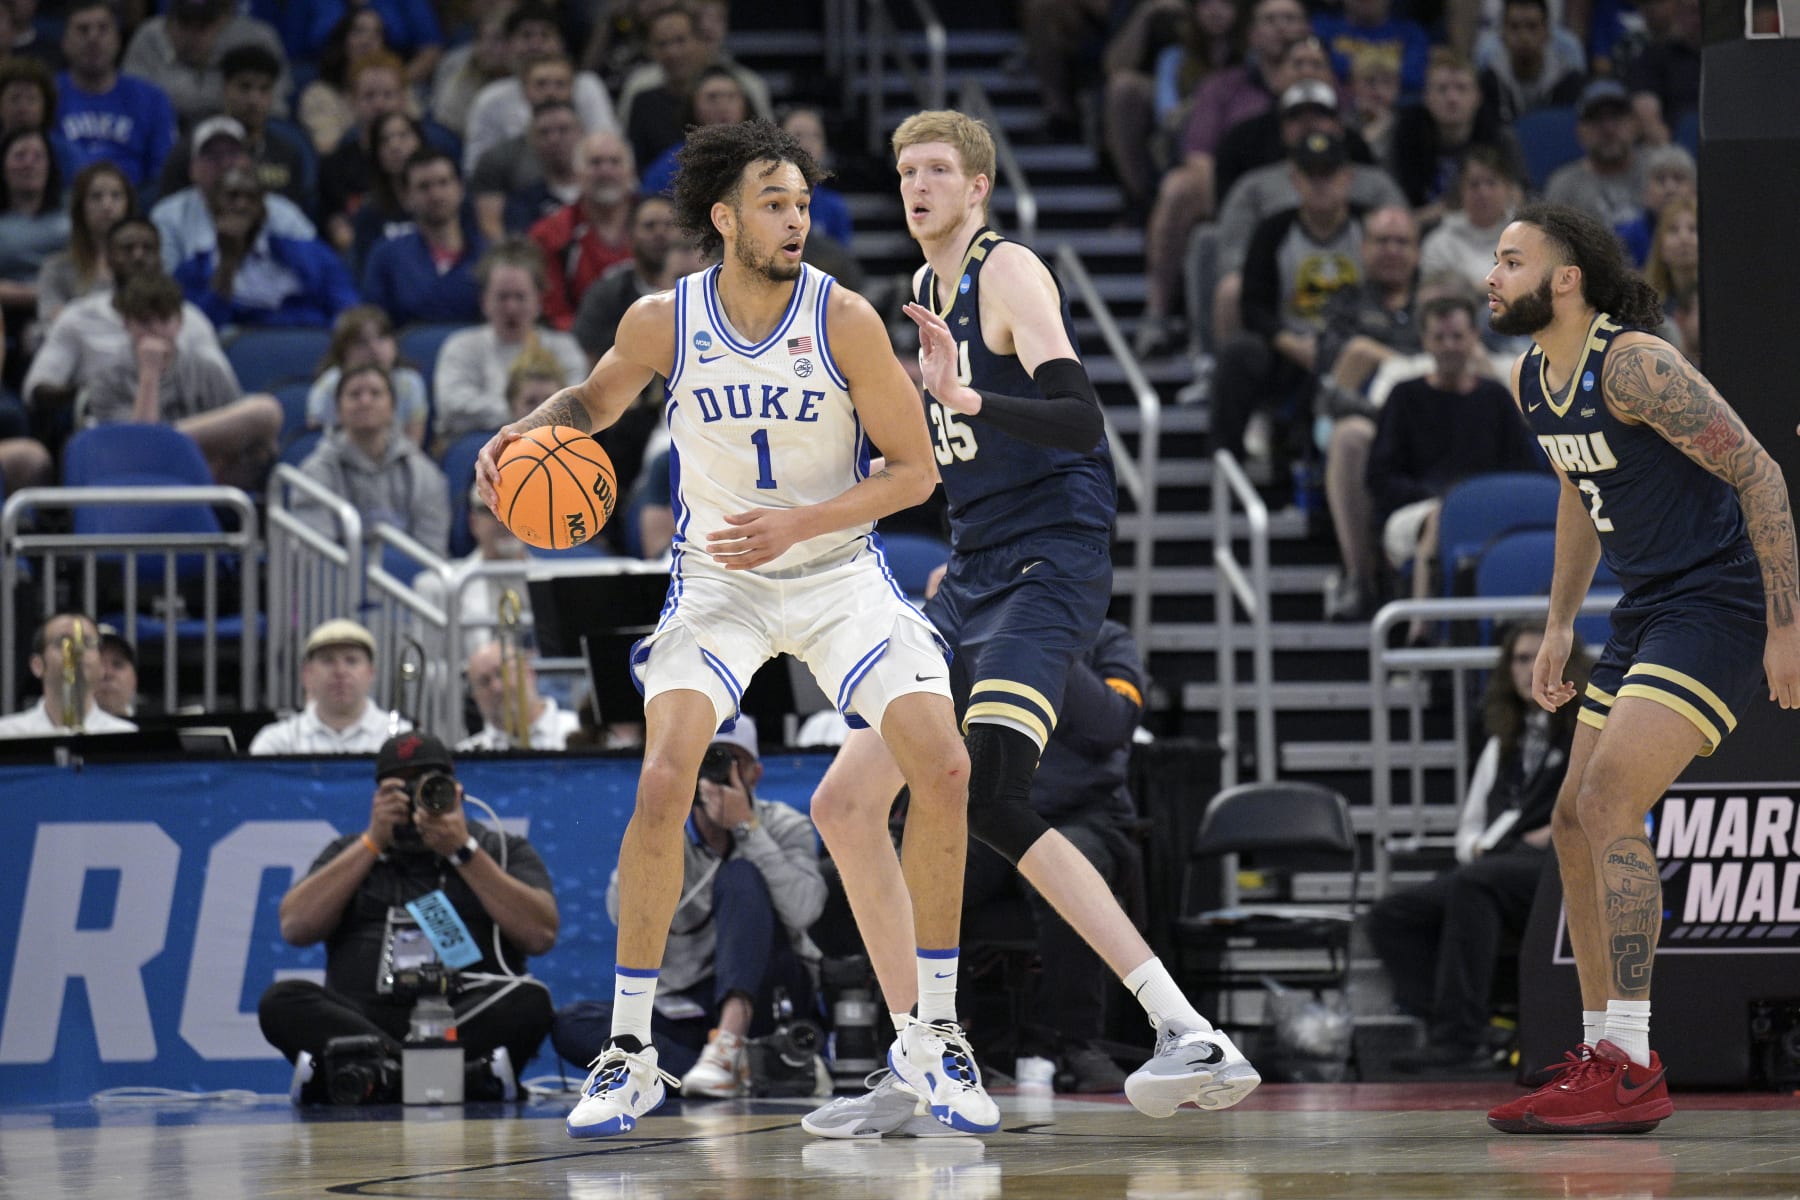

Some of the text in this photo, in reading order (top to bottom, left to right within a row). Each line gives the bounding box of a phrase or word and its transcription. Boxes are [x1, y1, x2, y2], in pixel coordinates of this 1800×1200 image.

[692, 384, 826, 423] DUKE
[930, 402, 979, 466] 35
[750, 428, 777, 490] 1
[1578, 479, 1615, 532] 2
[1656, 797, 1800, 859] MAR
[1612, 931, 1651, 991] 2
